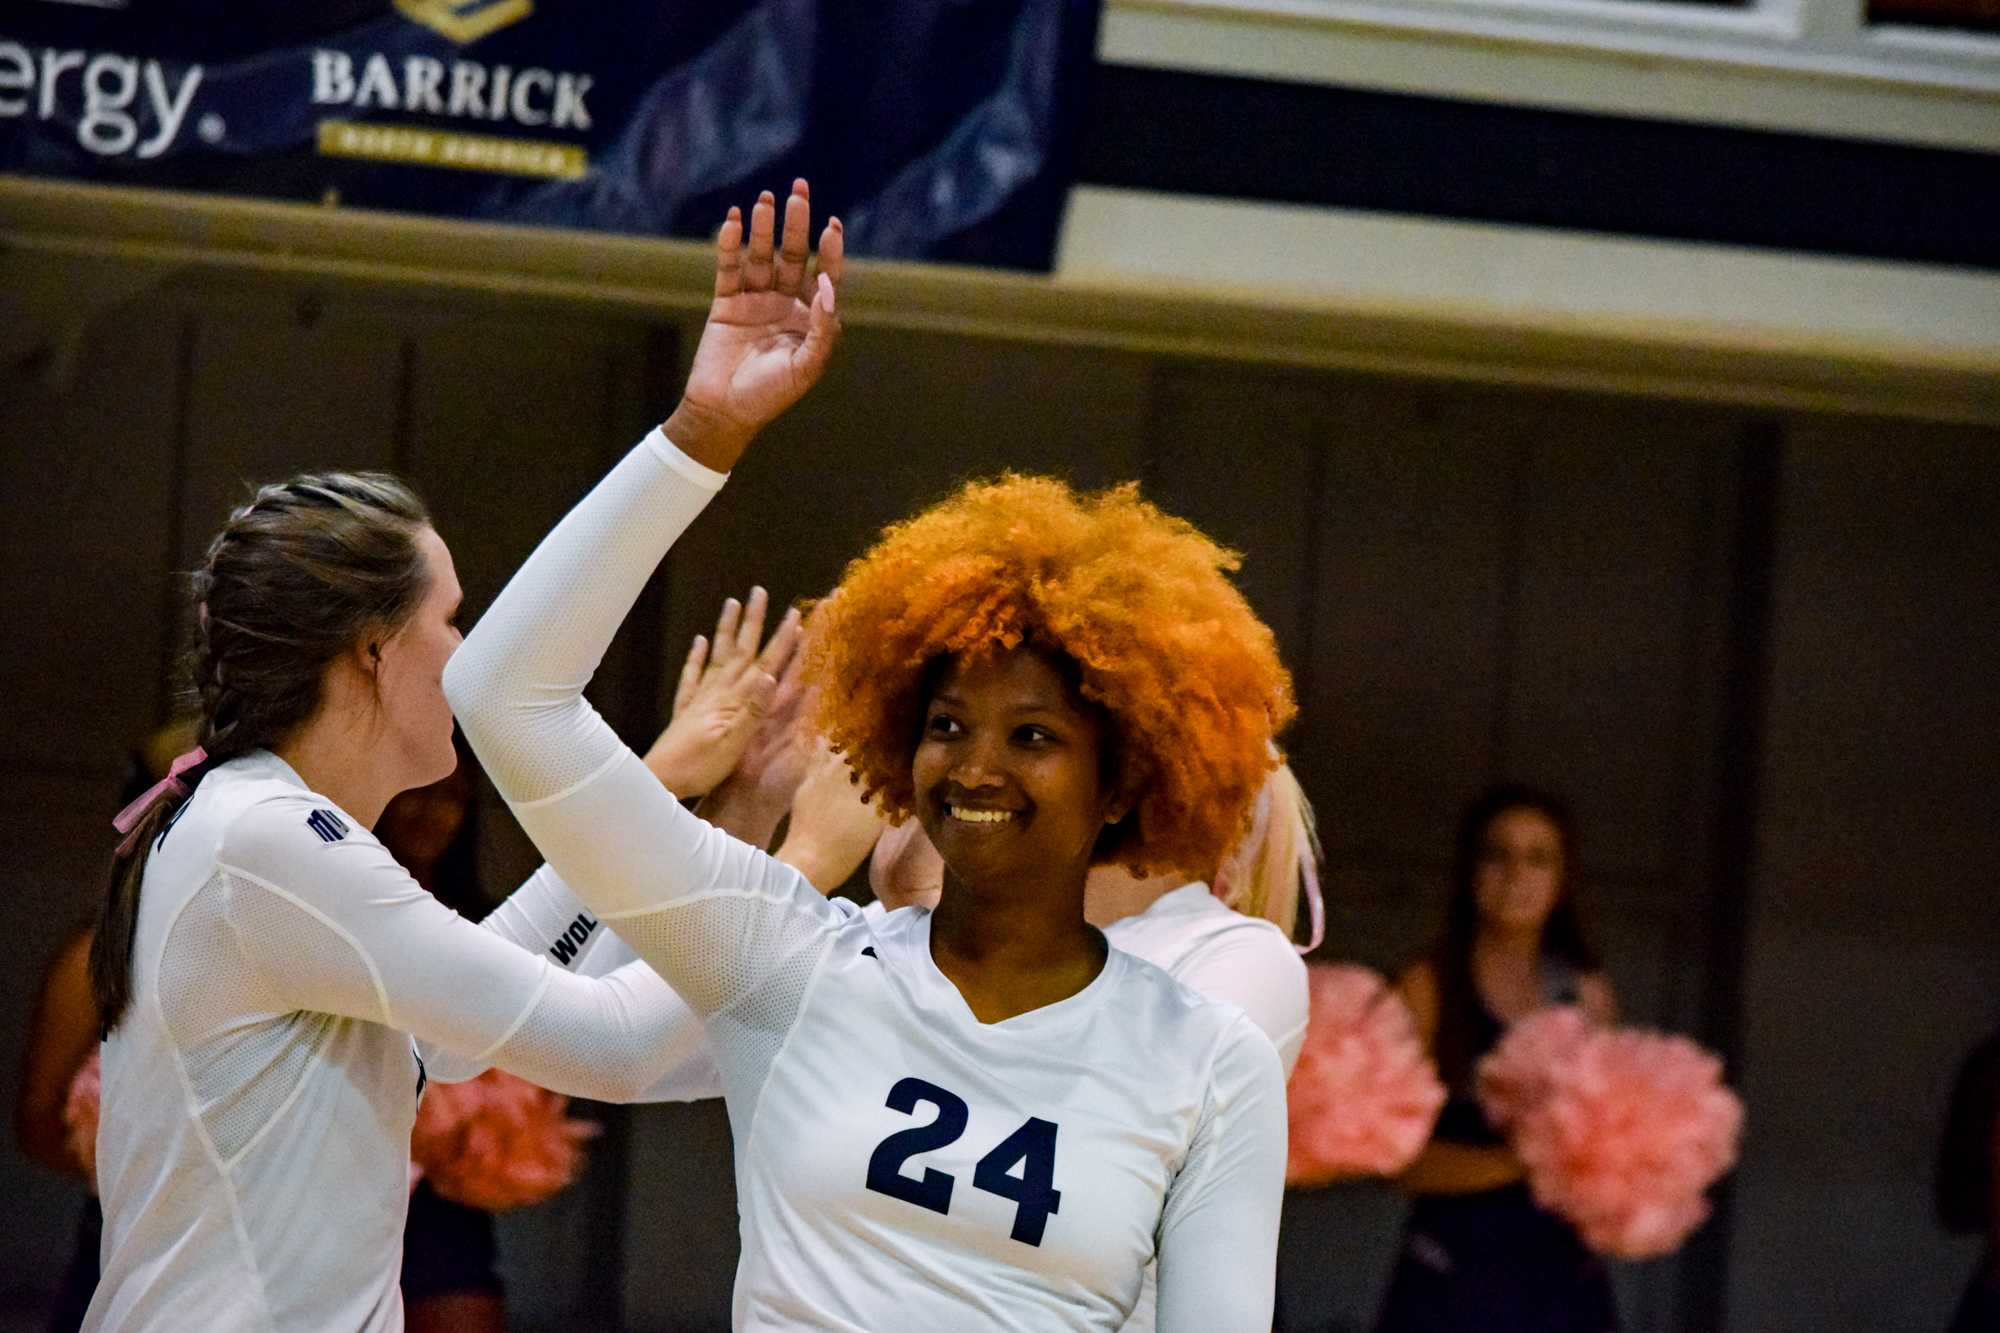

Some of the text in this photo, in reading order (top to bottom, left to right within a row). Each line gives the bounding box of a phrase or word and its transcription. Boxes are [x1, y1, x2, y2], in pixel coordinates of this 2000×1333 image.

[312, 50, 593, 130] BARRICK
[549, 906, 598, 966] WOL
[866, 1077, 1061, 1248] 24
